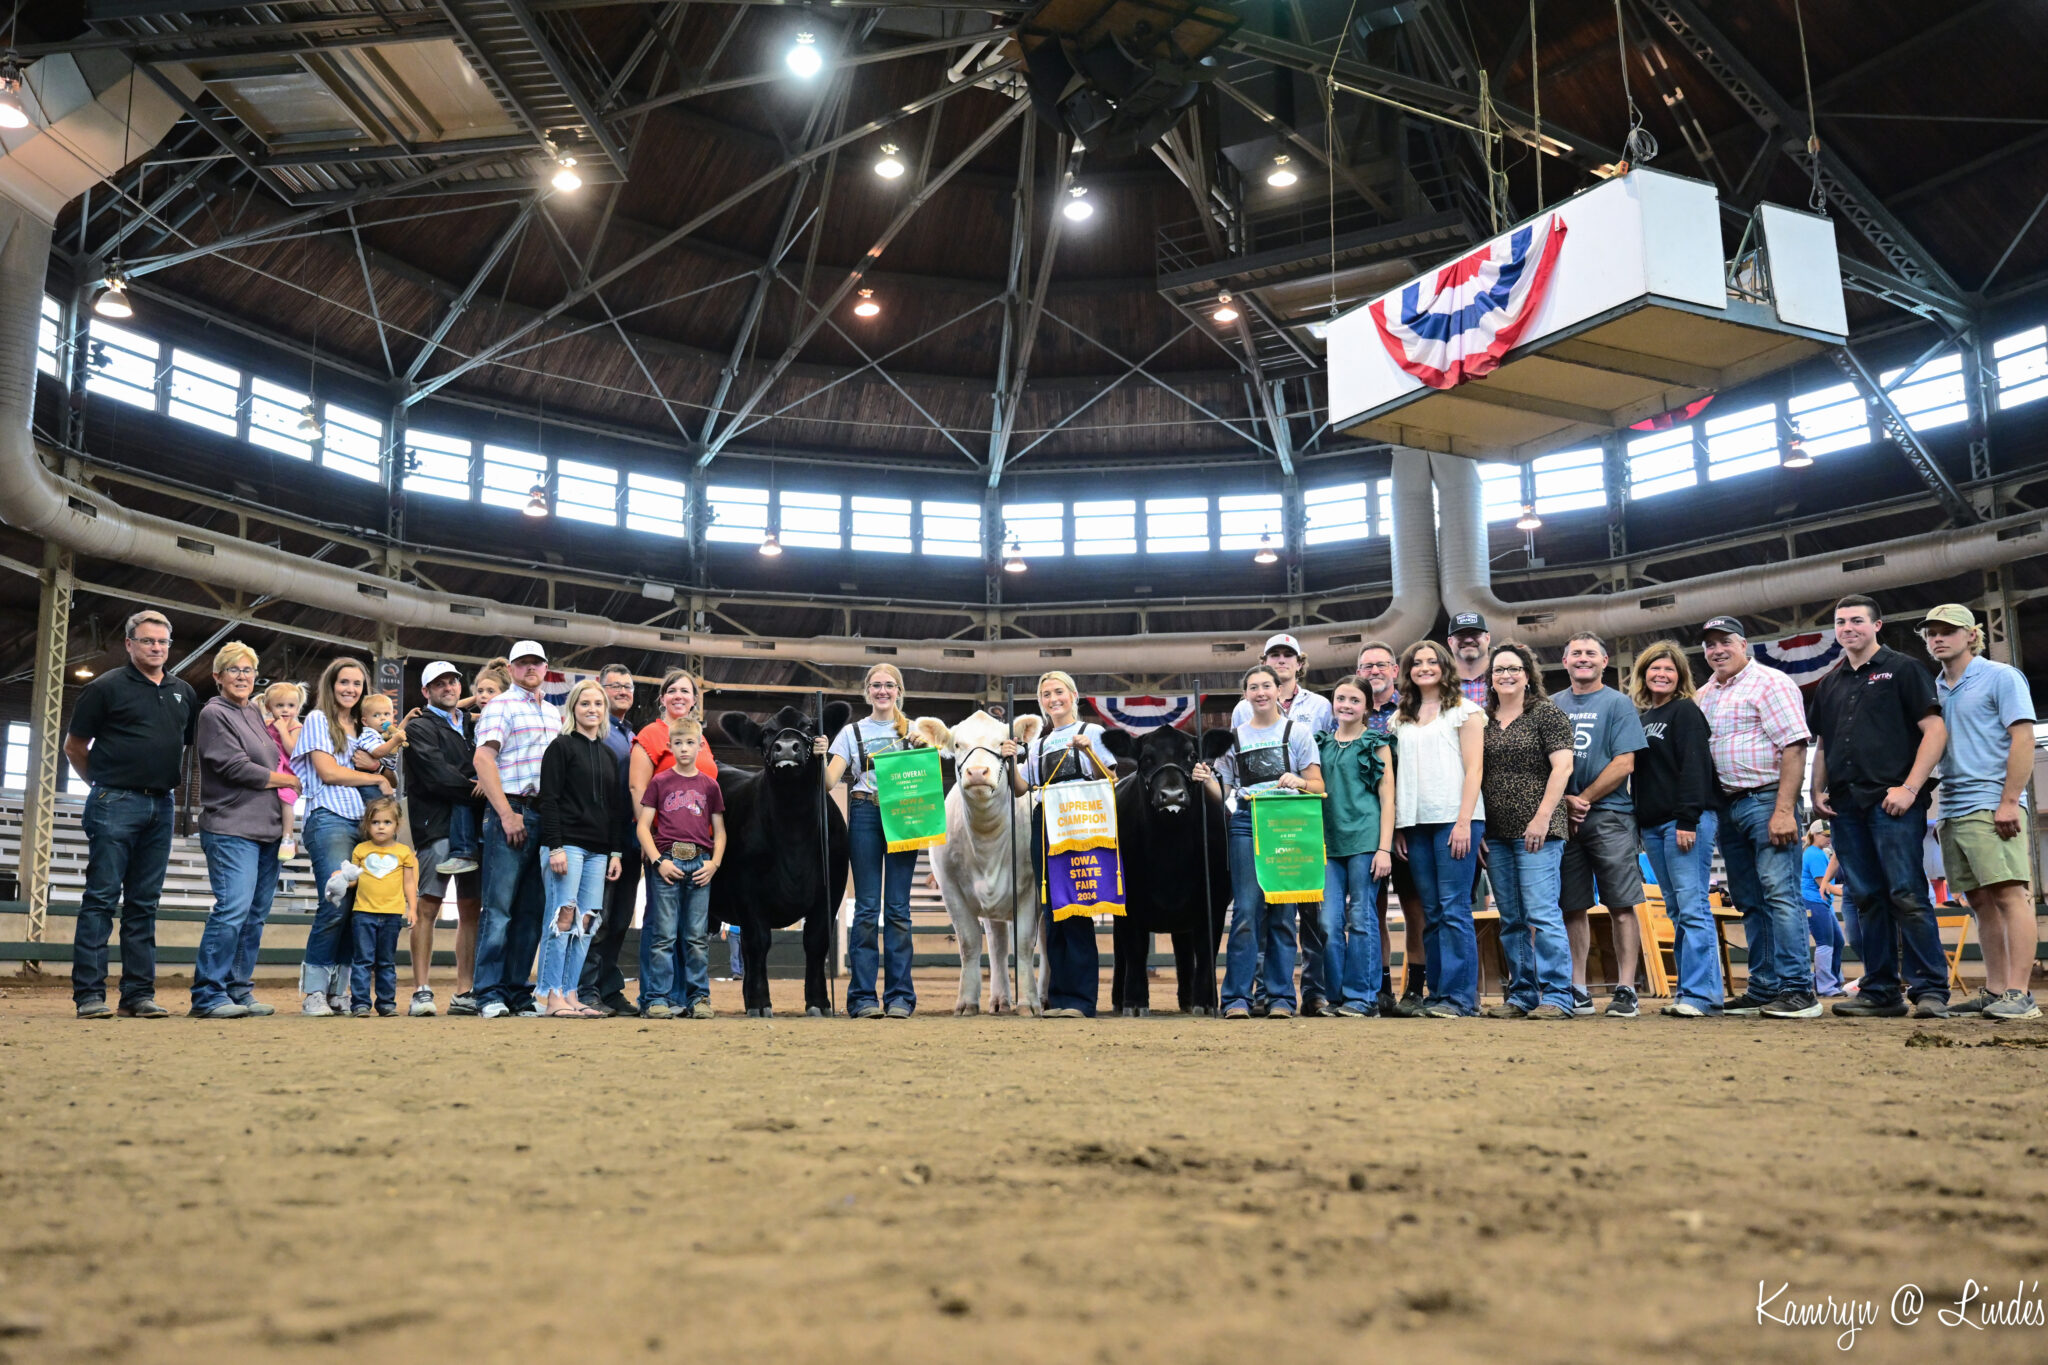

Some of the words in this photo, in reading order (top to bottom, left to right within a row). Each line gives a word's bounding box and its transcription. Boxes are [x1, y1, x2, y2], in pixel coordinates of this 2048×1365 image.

[1573, 723, 1595, 750] 5
[902, 769, 928, 778] OVERALL
[1058, 800, 1103, 813] SUPREME
[1057, 812, 1107, 828] CHAMPION
[1071, 855, 1099, 867] IOWA
[1069, 867, 1102, 879] STATE
[1075, 879, 1098, 891] FAIR
[1077, 892, 1098, 901] 2024
